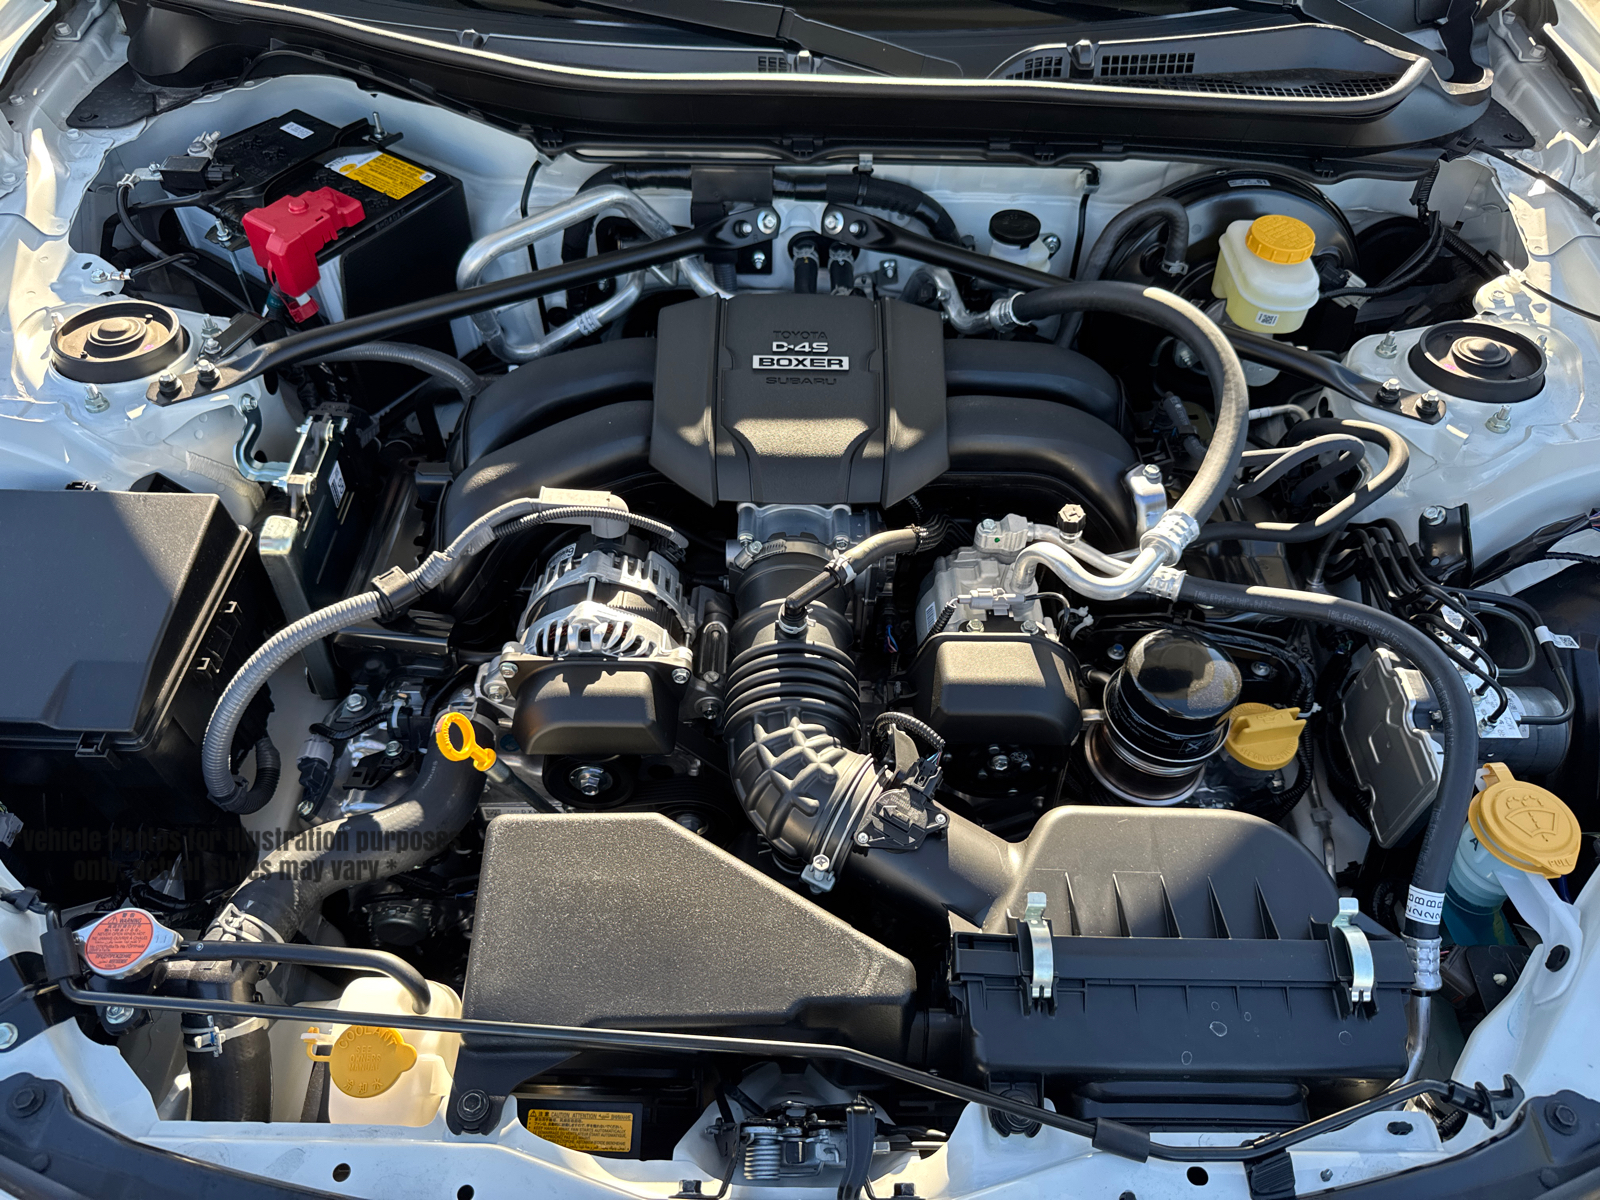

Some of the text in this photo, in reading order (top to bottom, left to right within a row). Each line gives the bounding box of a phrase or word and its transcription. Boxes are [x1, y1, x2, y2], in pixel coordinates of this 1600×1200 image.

[772, 330, 828, 339] TOYOTA
[772, 341, 828, 352] D-4S
[758, 358, 844, 368] BOXER
[766, 376, 837, 386] SUBARU
[1548, 858, 1573, 867] PULL
[340, 1026, 398, 1048] COOLANT
[356, 1045, 372, 1053] SEE
[350, 1054, 382, 1062] OWNERS
[349, 1063, 380, 1071] MANUAL
